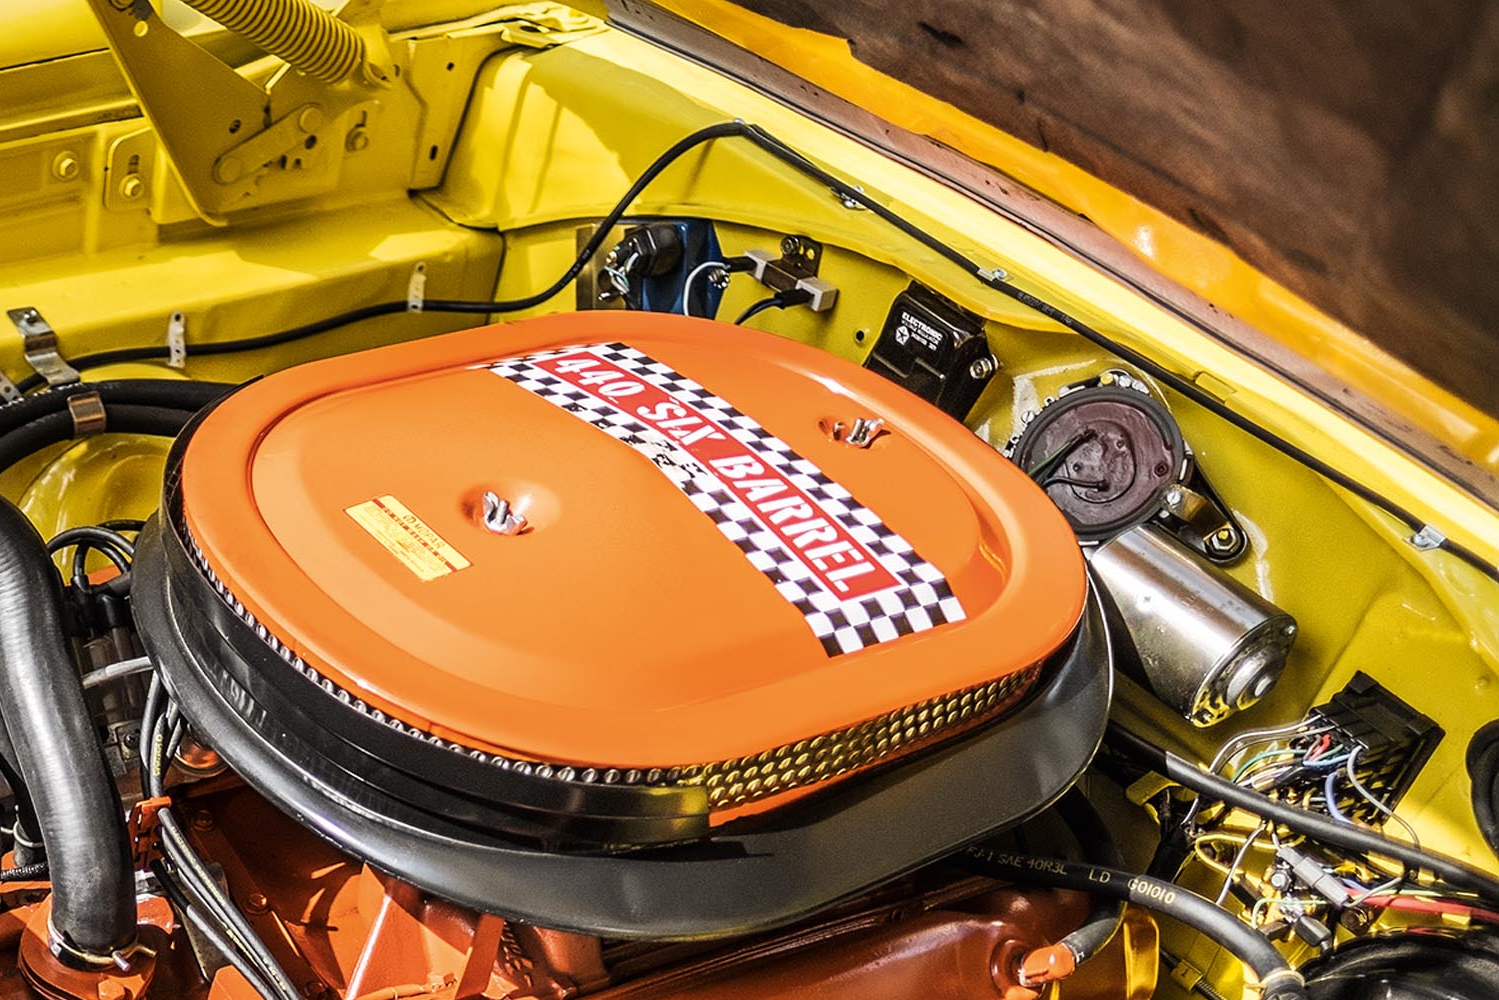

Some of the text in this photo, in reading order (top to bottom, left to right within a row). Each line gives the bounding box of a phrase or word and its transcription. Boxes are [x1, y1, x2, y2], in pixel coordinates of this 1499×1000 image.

[554, 358, 876, 593] 440 SIX BARREL
[997, 854, 1022, 869] SAE
